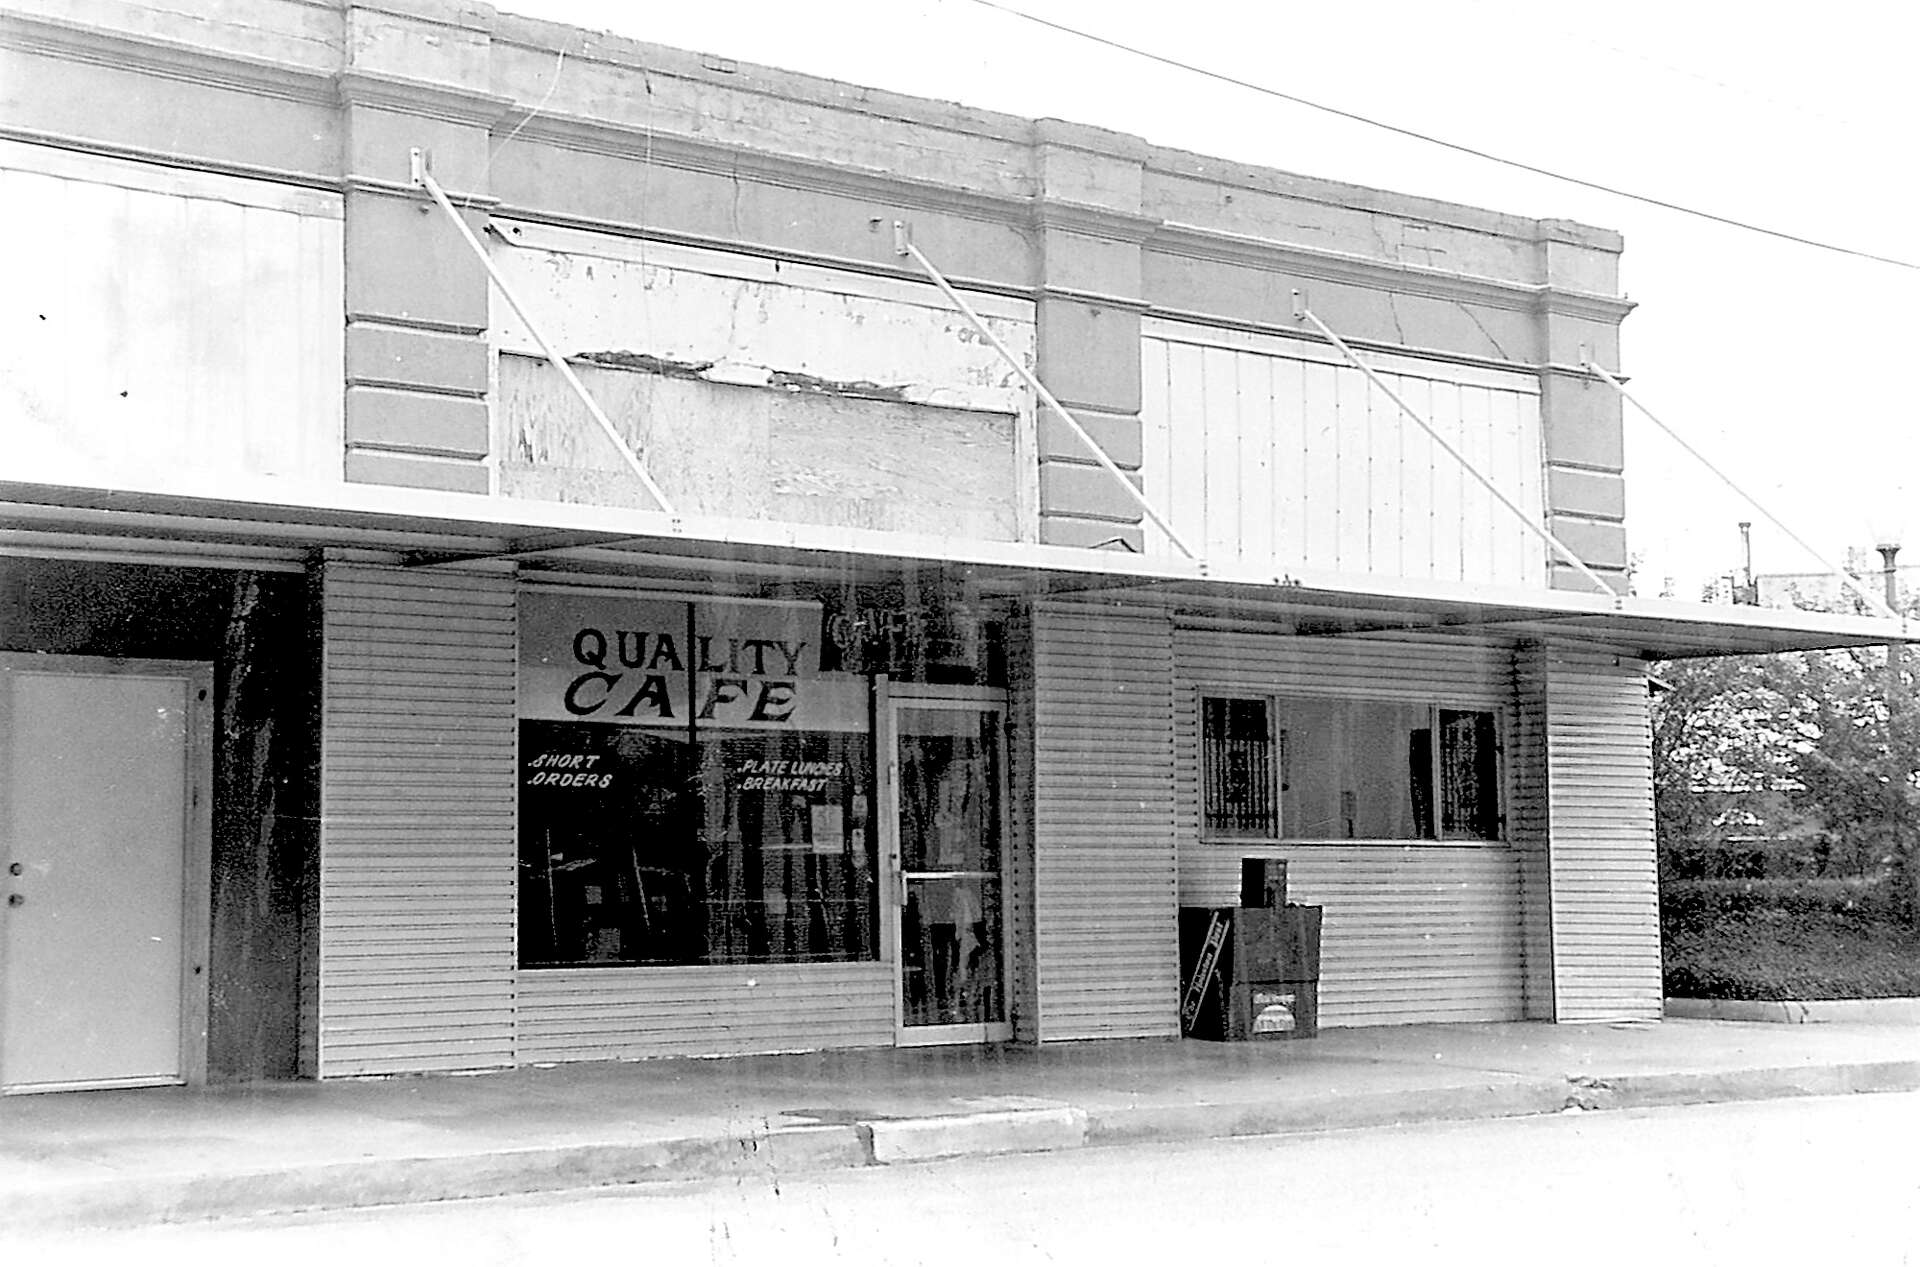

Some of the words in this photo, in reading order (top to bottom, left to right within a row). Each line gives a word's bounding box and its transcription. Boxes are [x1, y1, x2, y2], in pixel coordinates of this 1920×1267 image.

[573, 628, 807, 676] QUALITY
[564, 671, 797, 722] CAFE
[532, 753, 601, 769] SHORT
[742, 759, 790, 774] PLATE
[532, 771, 613, 788] ORDERS
[742, 776, 829, 792] BREAKFAST
